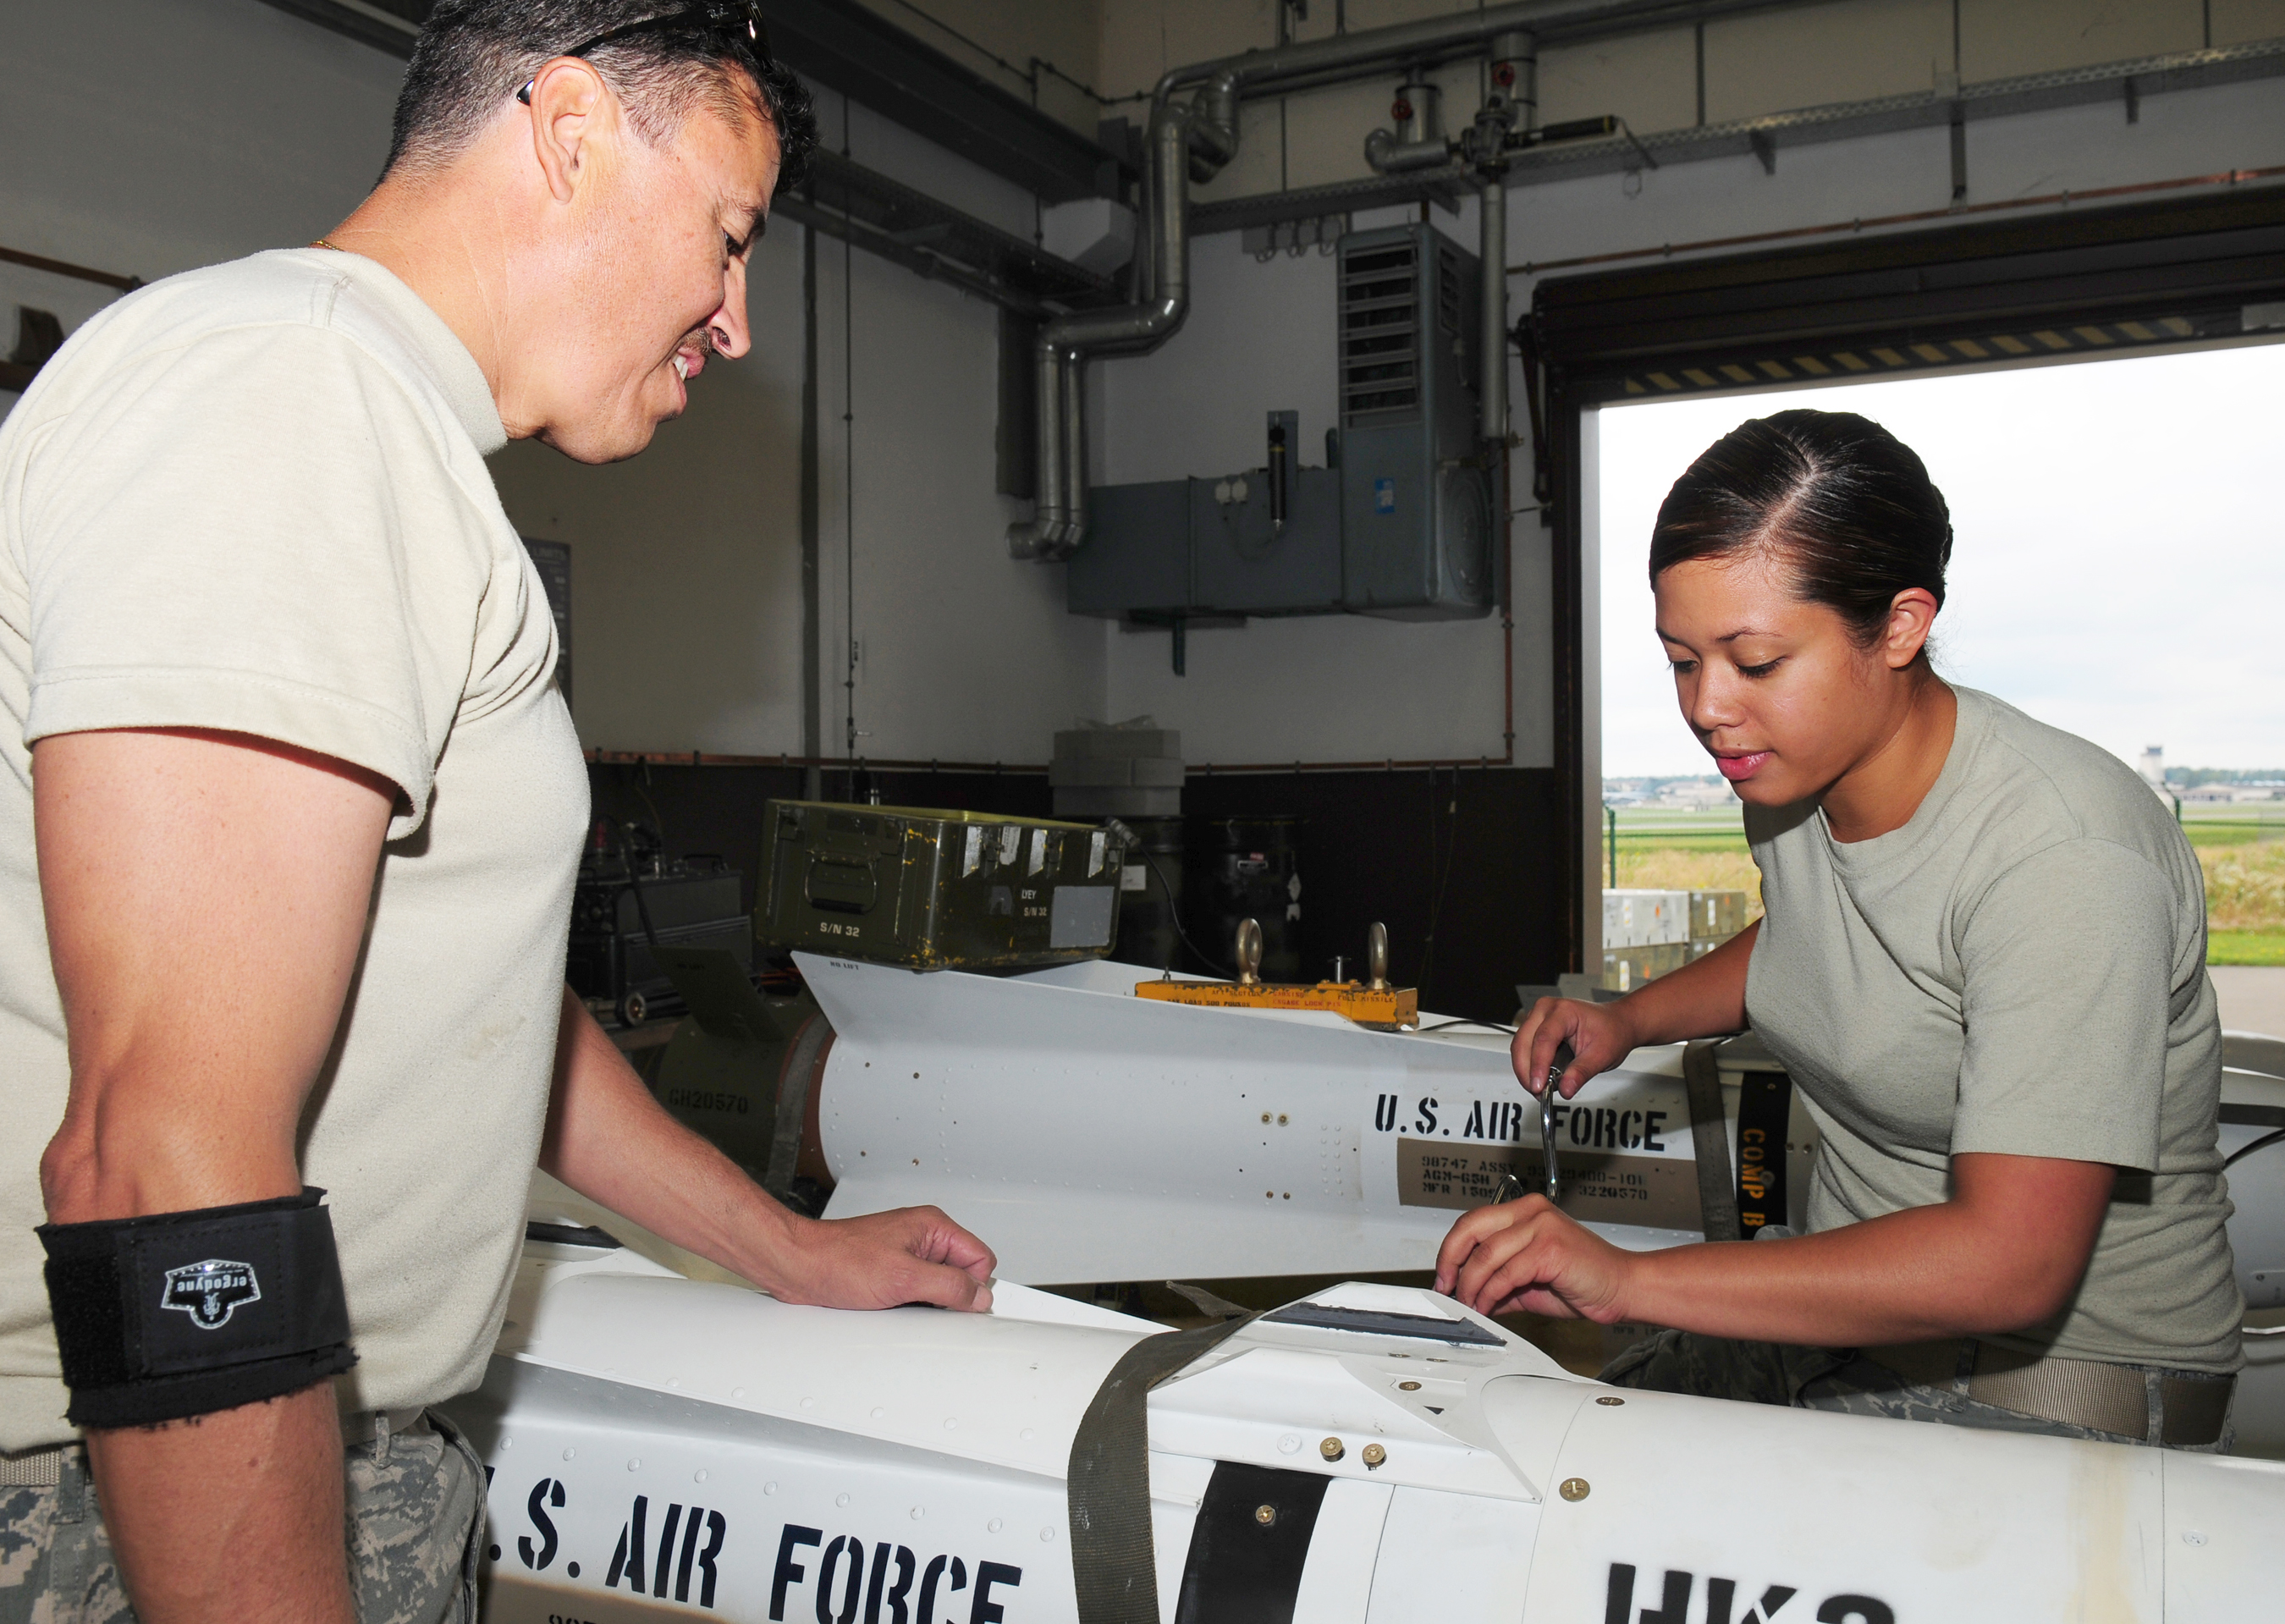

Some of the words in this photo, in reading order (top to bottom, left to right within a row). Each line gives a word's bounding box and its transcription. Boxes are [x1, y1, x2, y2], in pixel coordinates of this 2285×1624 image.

[1023, 906, 1038, 917] S/N
[1038, 906, 1048, 917] 32
[819, 922, 843, 936] S/N
[844, 926, 860, 938] 32
[843, 962, 859, 971] LIFT
[1375, 1093, 1450, 1137] U.S.
[1464, 1100, 1522, 1142] AIR
[1553, 1104, 1667, 1152] FORCE
[1422, 1156, 1468, 1170] 98747
[1479, 1161, 1517, 1174] ASSY
[1742, 1128, 1766, 1199] COMP
[1423, 1182, 1451, 1195] MFR
[1578, 1186, 1649, 1200] 3220570
[1742, 1212, 1765, 1226] B
[176, 1274, 247, 1293] ergodyne
[485, 1466, 581, 1579] .S.
[605, 1495, 726, 1609] AIR
[768, 1522, 1023, 1624] FORCE
